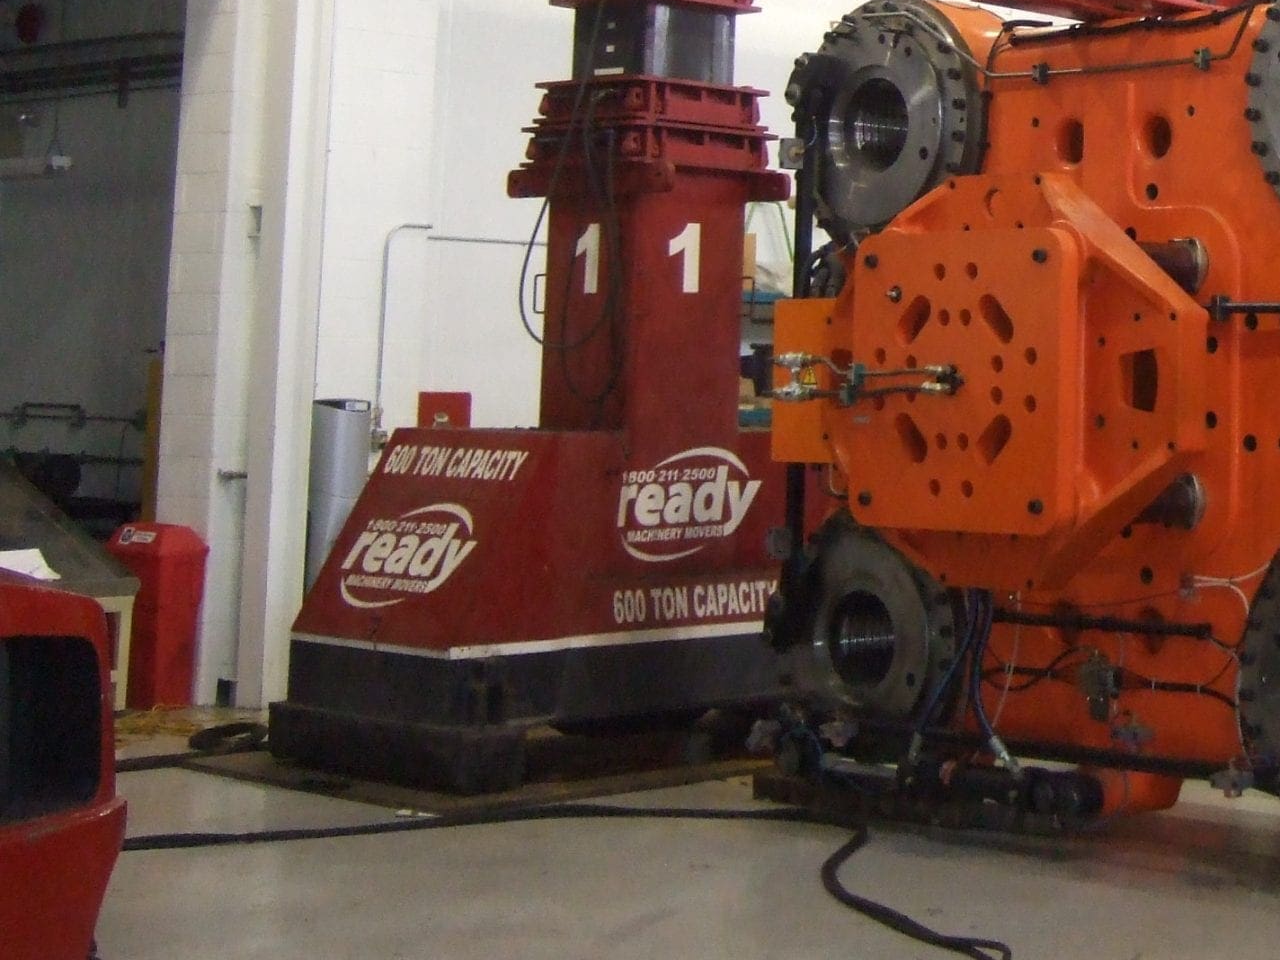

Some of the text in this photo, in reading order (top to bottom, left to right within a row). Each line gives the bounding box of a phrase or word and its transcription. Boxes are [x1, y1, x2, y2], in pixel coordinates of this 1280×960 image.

[575, 223, 600, 294] 1
[668, 222, 701, 294] 1
[384, 444, 530, 481] 600 TON CAPACITY
[617, 465, 762, 537] ready
[627, 524, 725, 542] MACHINERY MOVERS
[341, 523, 478, 594] ready
[613, 590, 646, 624] 600
[651, 585, 688, 620] TON
